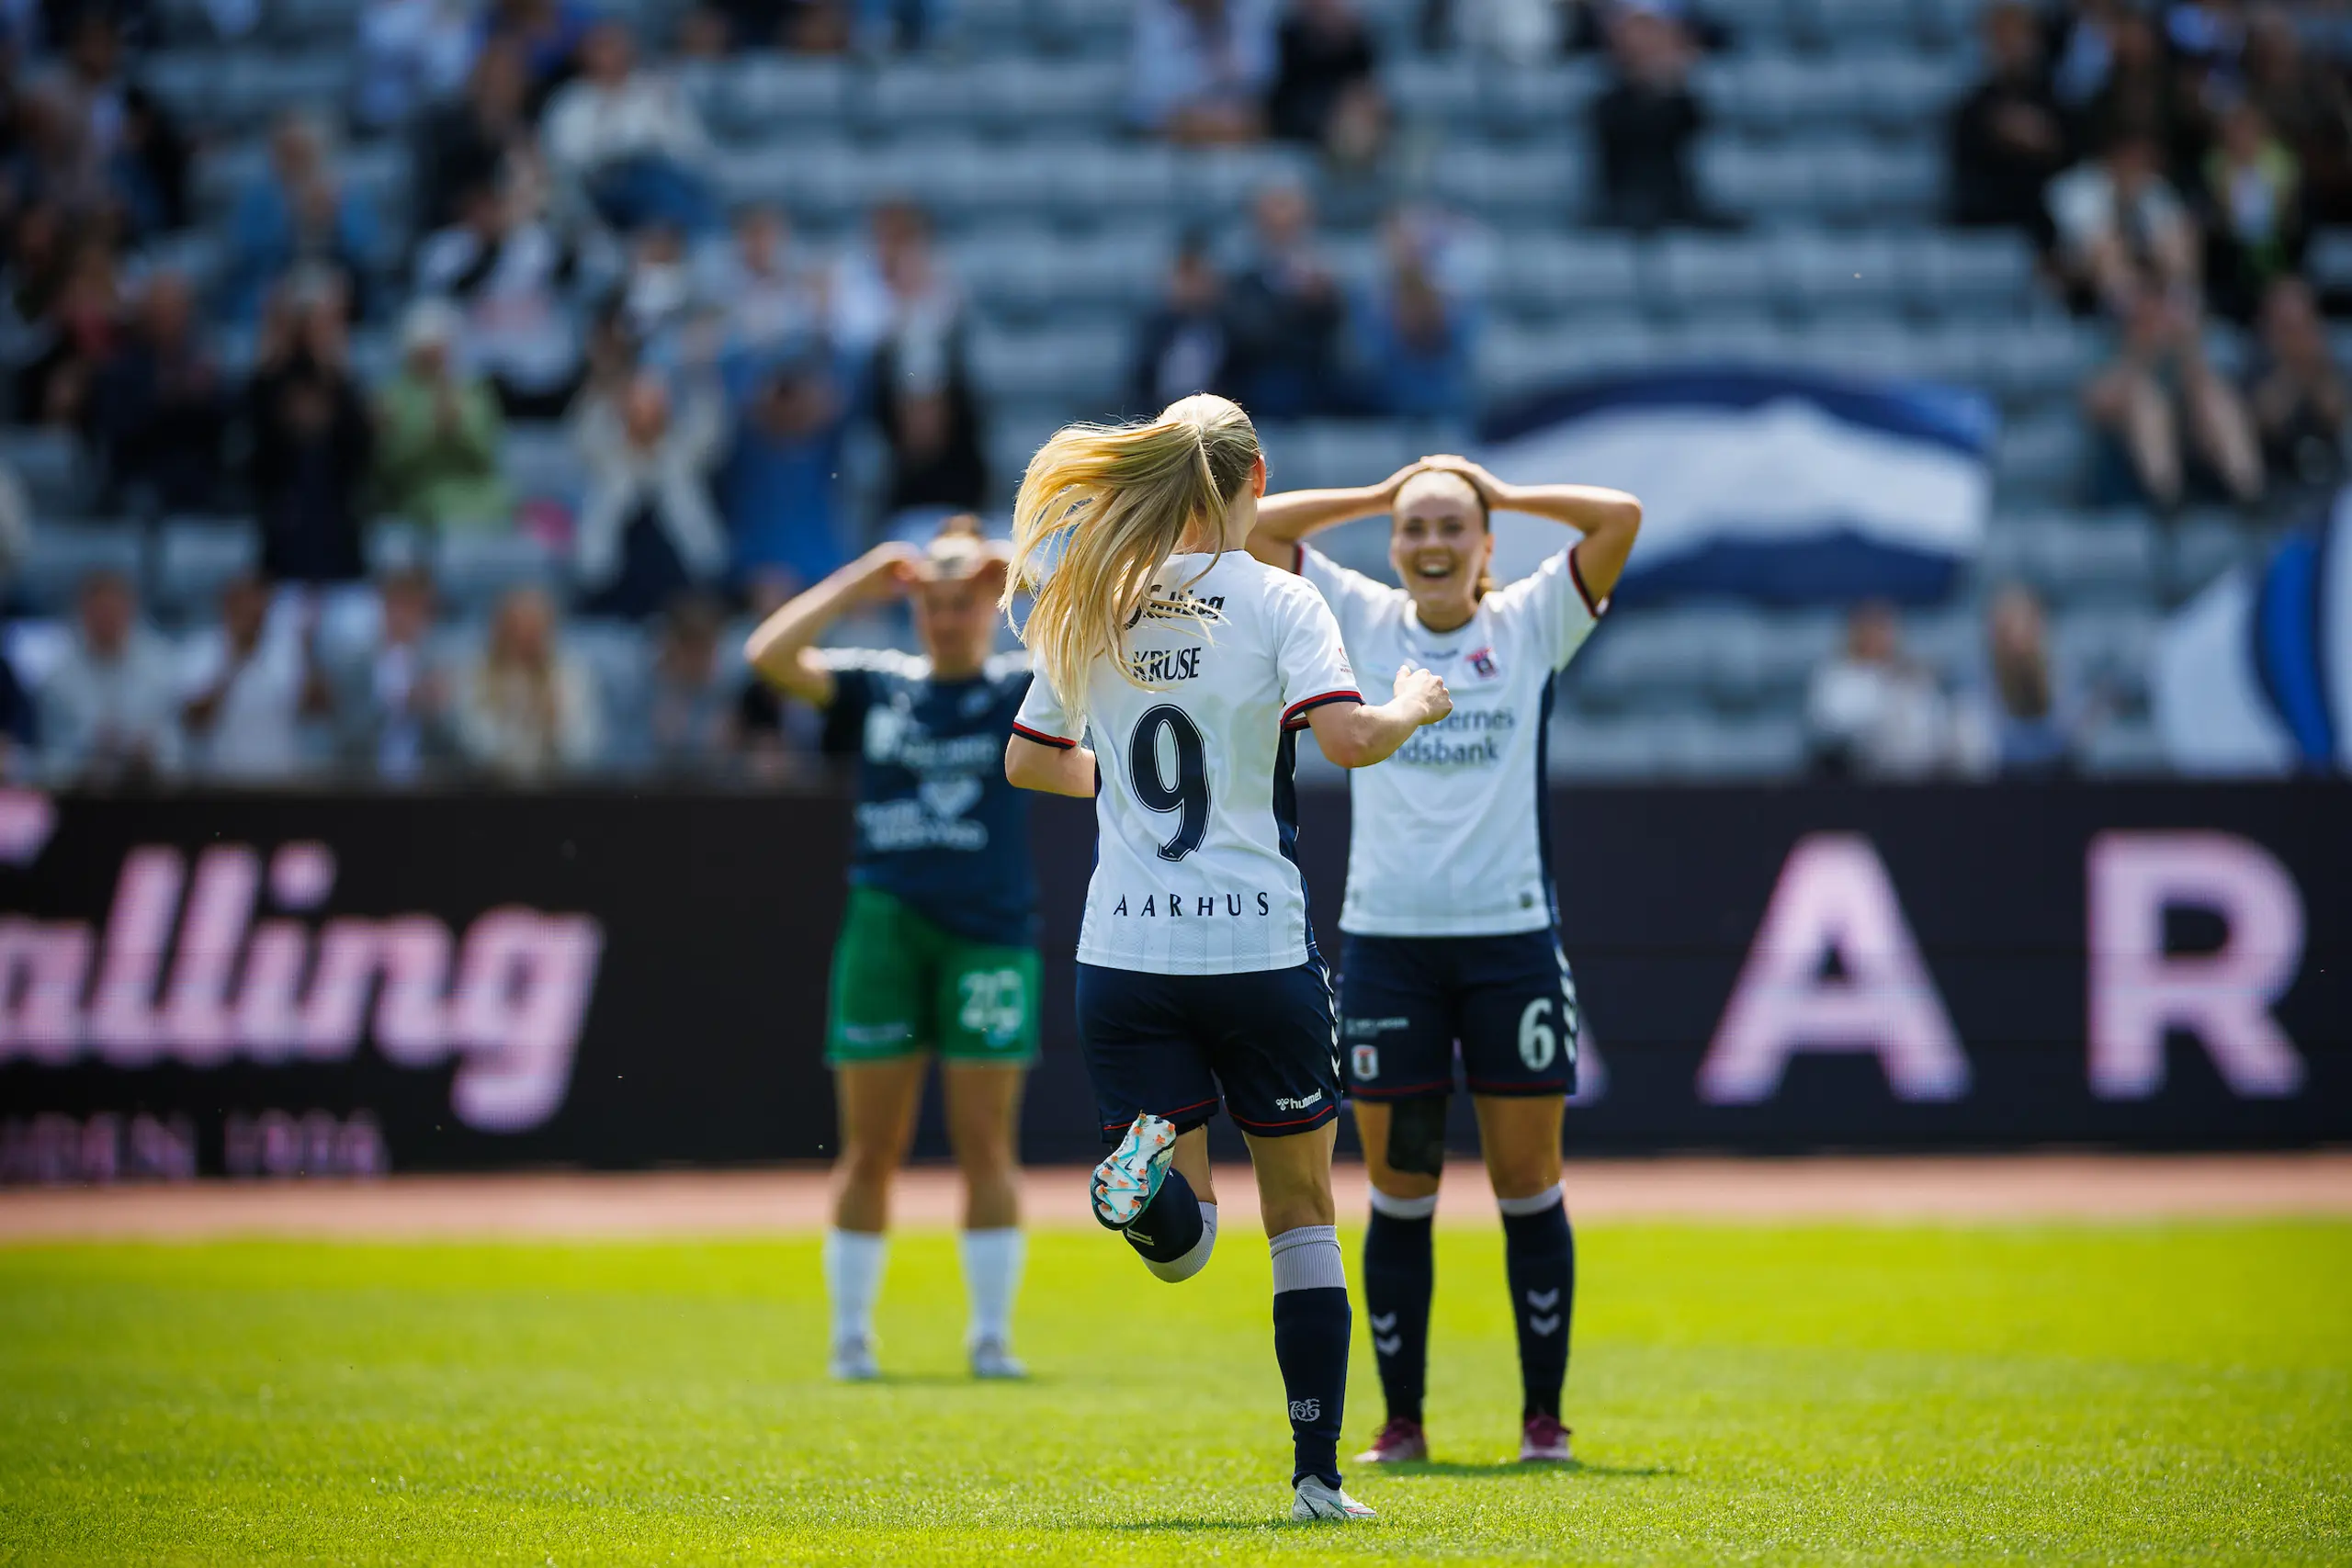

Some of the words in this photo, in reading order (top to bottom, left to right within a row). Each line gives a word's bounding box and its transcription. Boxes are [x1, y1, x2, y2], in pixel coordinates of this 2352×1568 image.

[1133, 647, 1202, 682] KRUSE
[1128, 704, 1211, 862] 9
[1113, 891, 1271, 918] AARHUS
[1518, 998, 1556, 1072] 6
[1290, 1088, 1323, 1110] hummel
